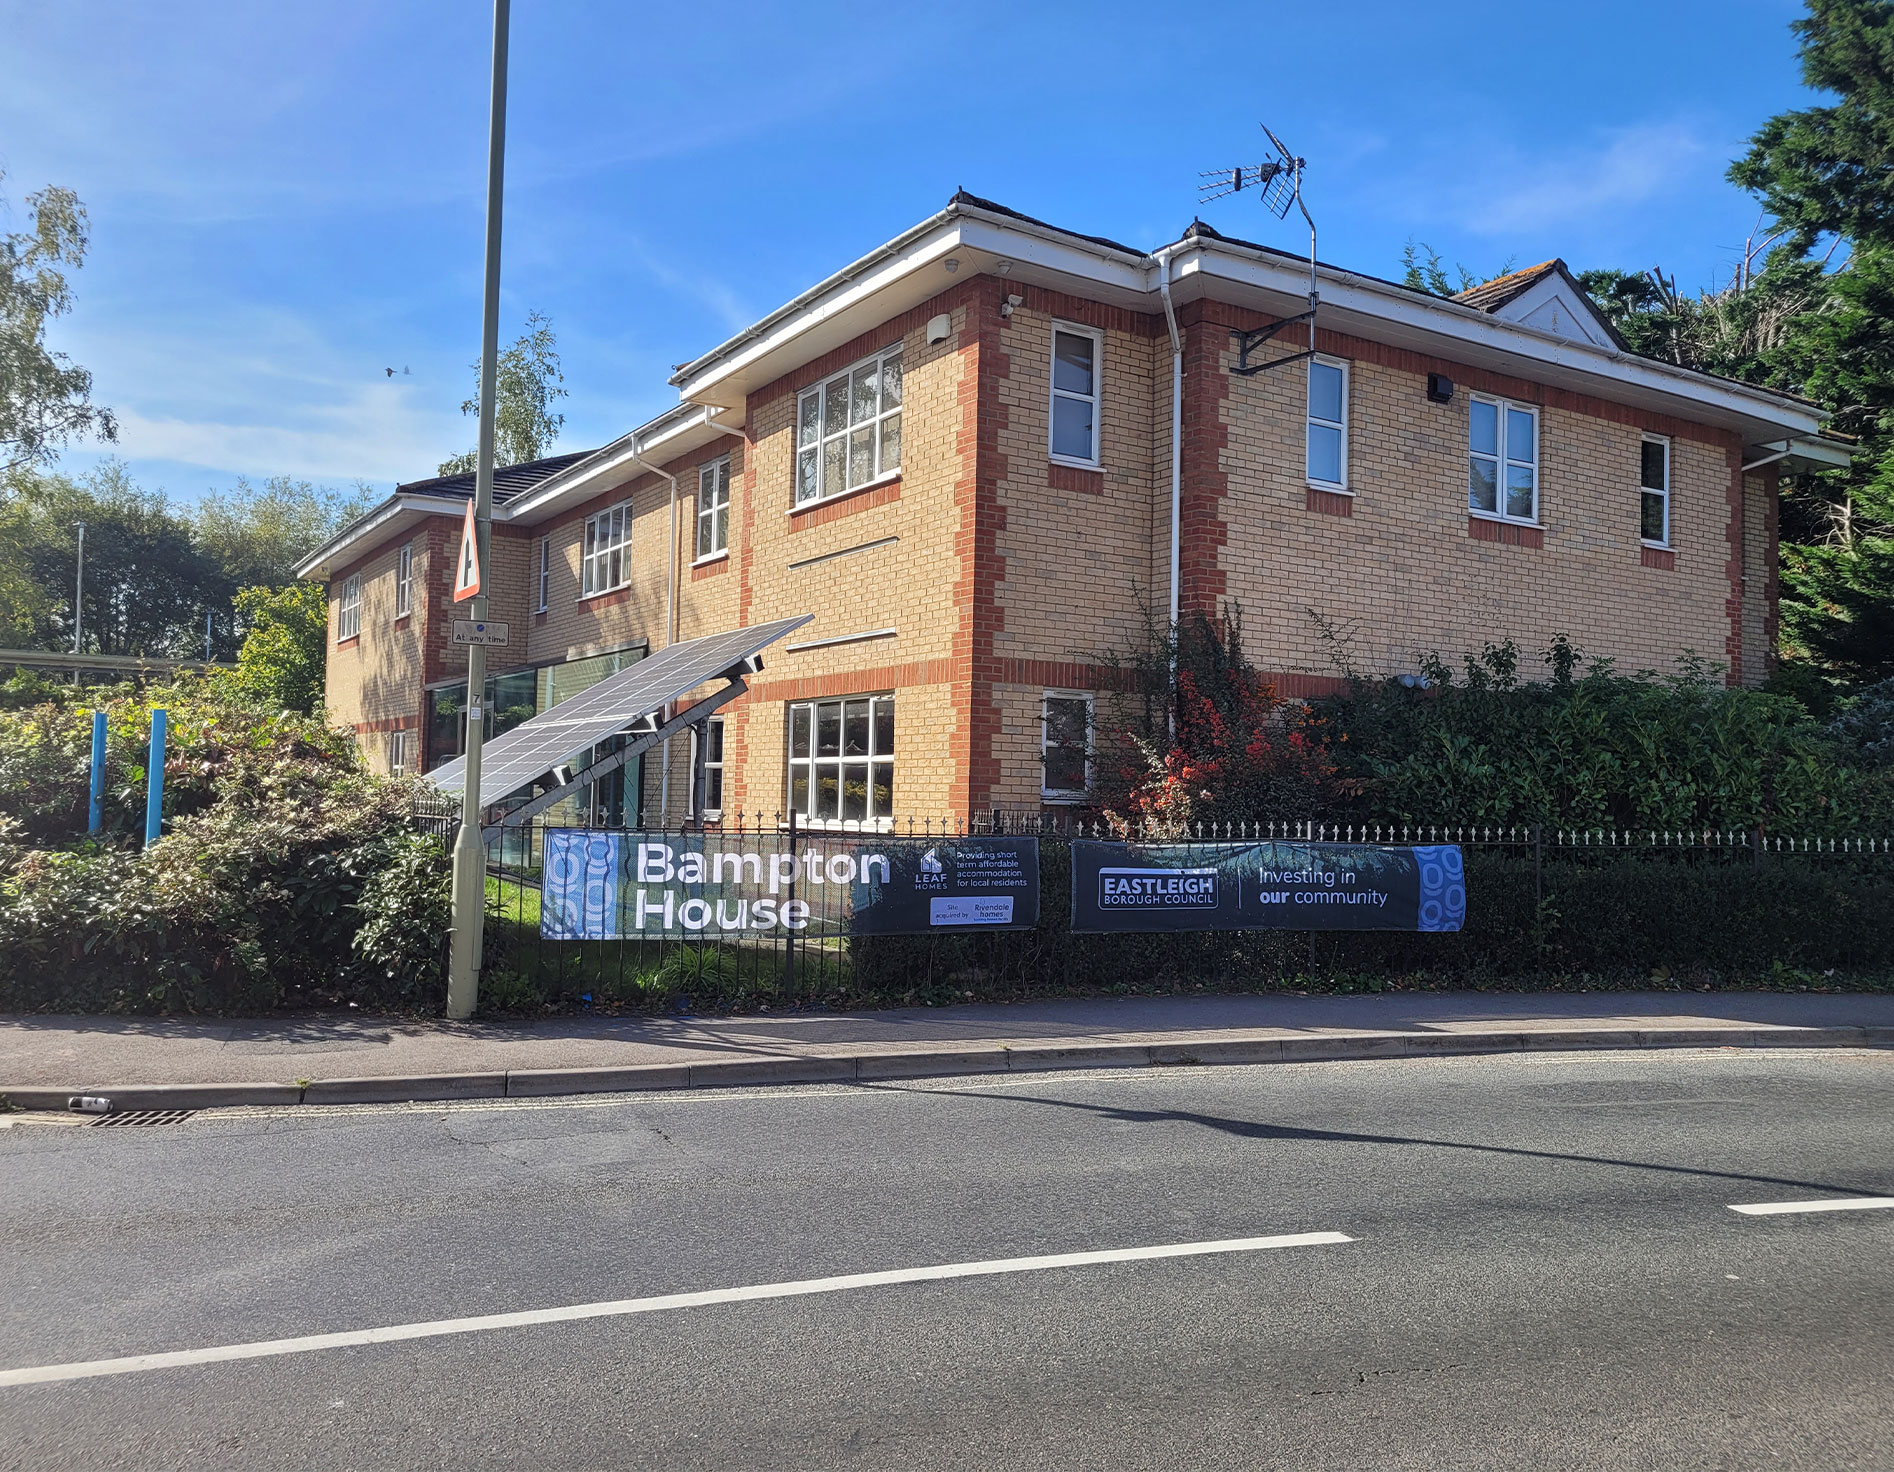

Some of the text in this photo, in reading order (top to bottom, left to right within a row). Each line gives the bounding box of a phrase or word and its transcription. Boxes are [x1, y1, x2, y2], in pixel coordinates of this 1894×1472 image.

[456, 633, 506, 643] At any time
[473, 694, 480, 703] 7
[957, 851, 1017, 860] Providing short
[637, 843, 890, 894] Bampton
[978, 860, 1019, 868] affordable
[957, 869, 1022, 877] accommodation
[1260, 867, 1356, 887] Investing in
[915, 874, 947, 883] LEAF
[957, 879, 1028, 887] for local residents
[1104, 878, 1213, 894] EASTLEIGH
[1104, 894, 1213, 905] BOROUGH COUNCIL
[1260, 889, 1388, 907] our community
[635, 889, 810, 930] House
